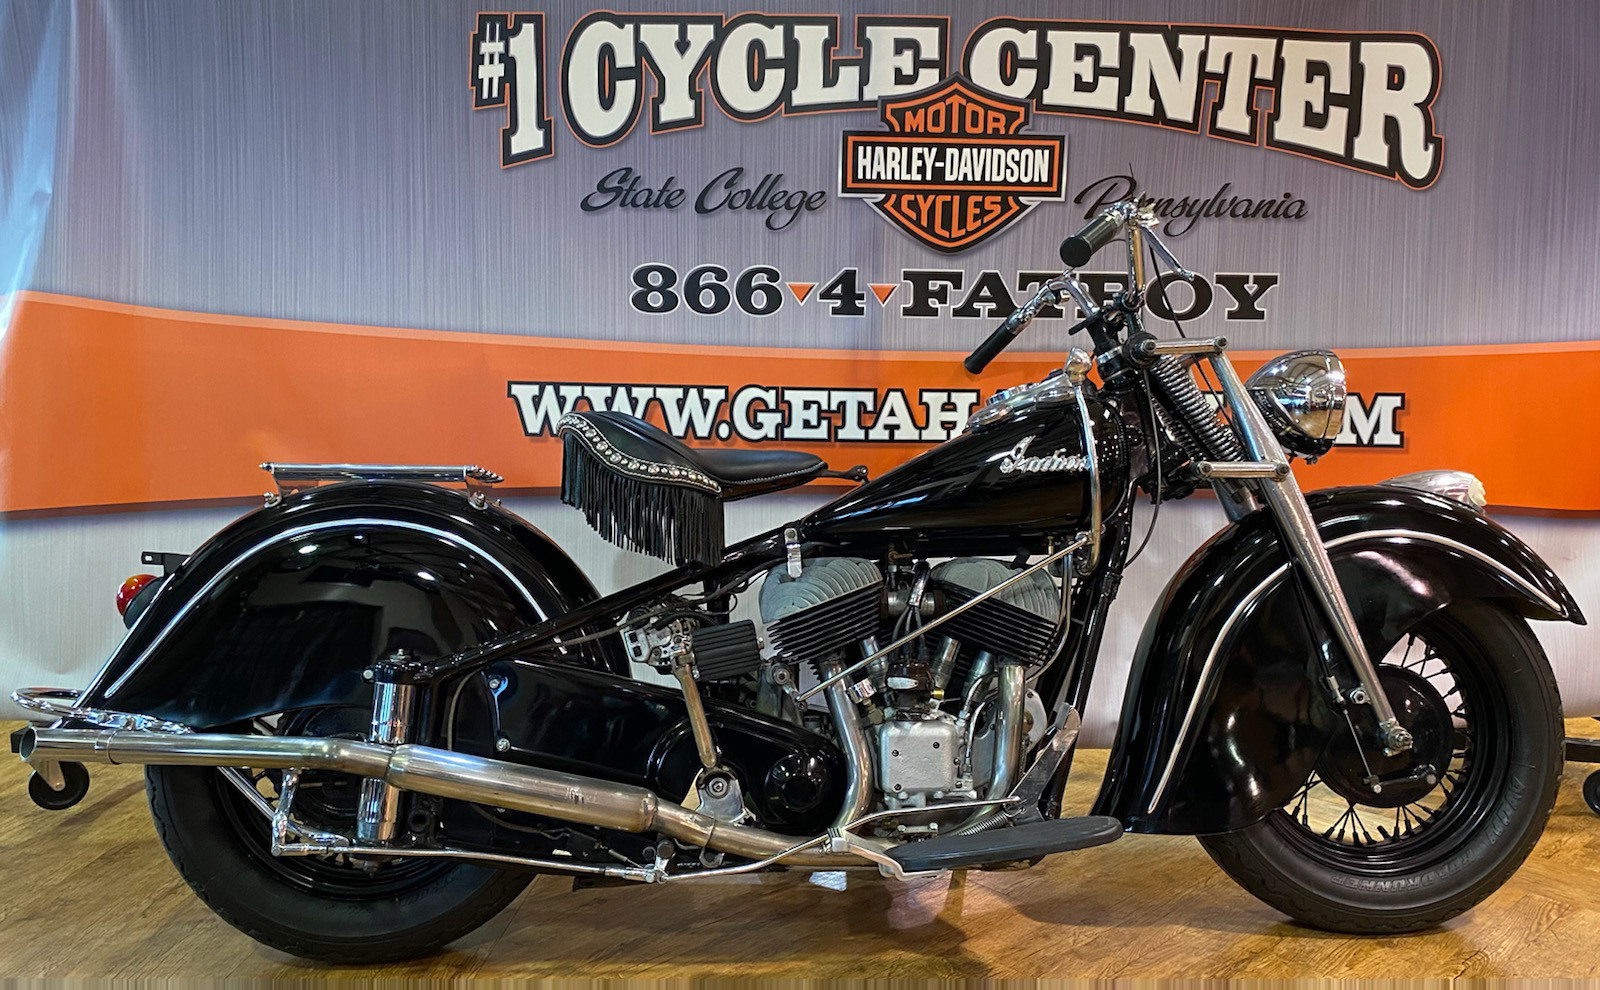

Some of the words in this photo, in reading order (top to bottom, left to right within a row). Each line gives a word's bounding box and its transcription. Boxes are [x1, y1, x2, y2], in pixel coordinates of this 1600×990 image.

[479, 22, 545, 155] #1
[568, 20, 940, 139] CYCLE
[969, 26, 1436, 180] CENTER
[904, 94, 1006, 134] MOTOR
[857, 146, 1050, 183] HARLEY-DAVIDSON
[580, 167, 686, 212] State
[694, 167, 827, 231] College
[901, 194, 1002, 239] CYCLES
[1073, 175, 1309, 237] Pnsylvania
[630, 264, 783, 316] 866
